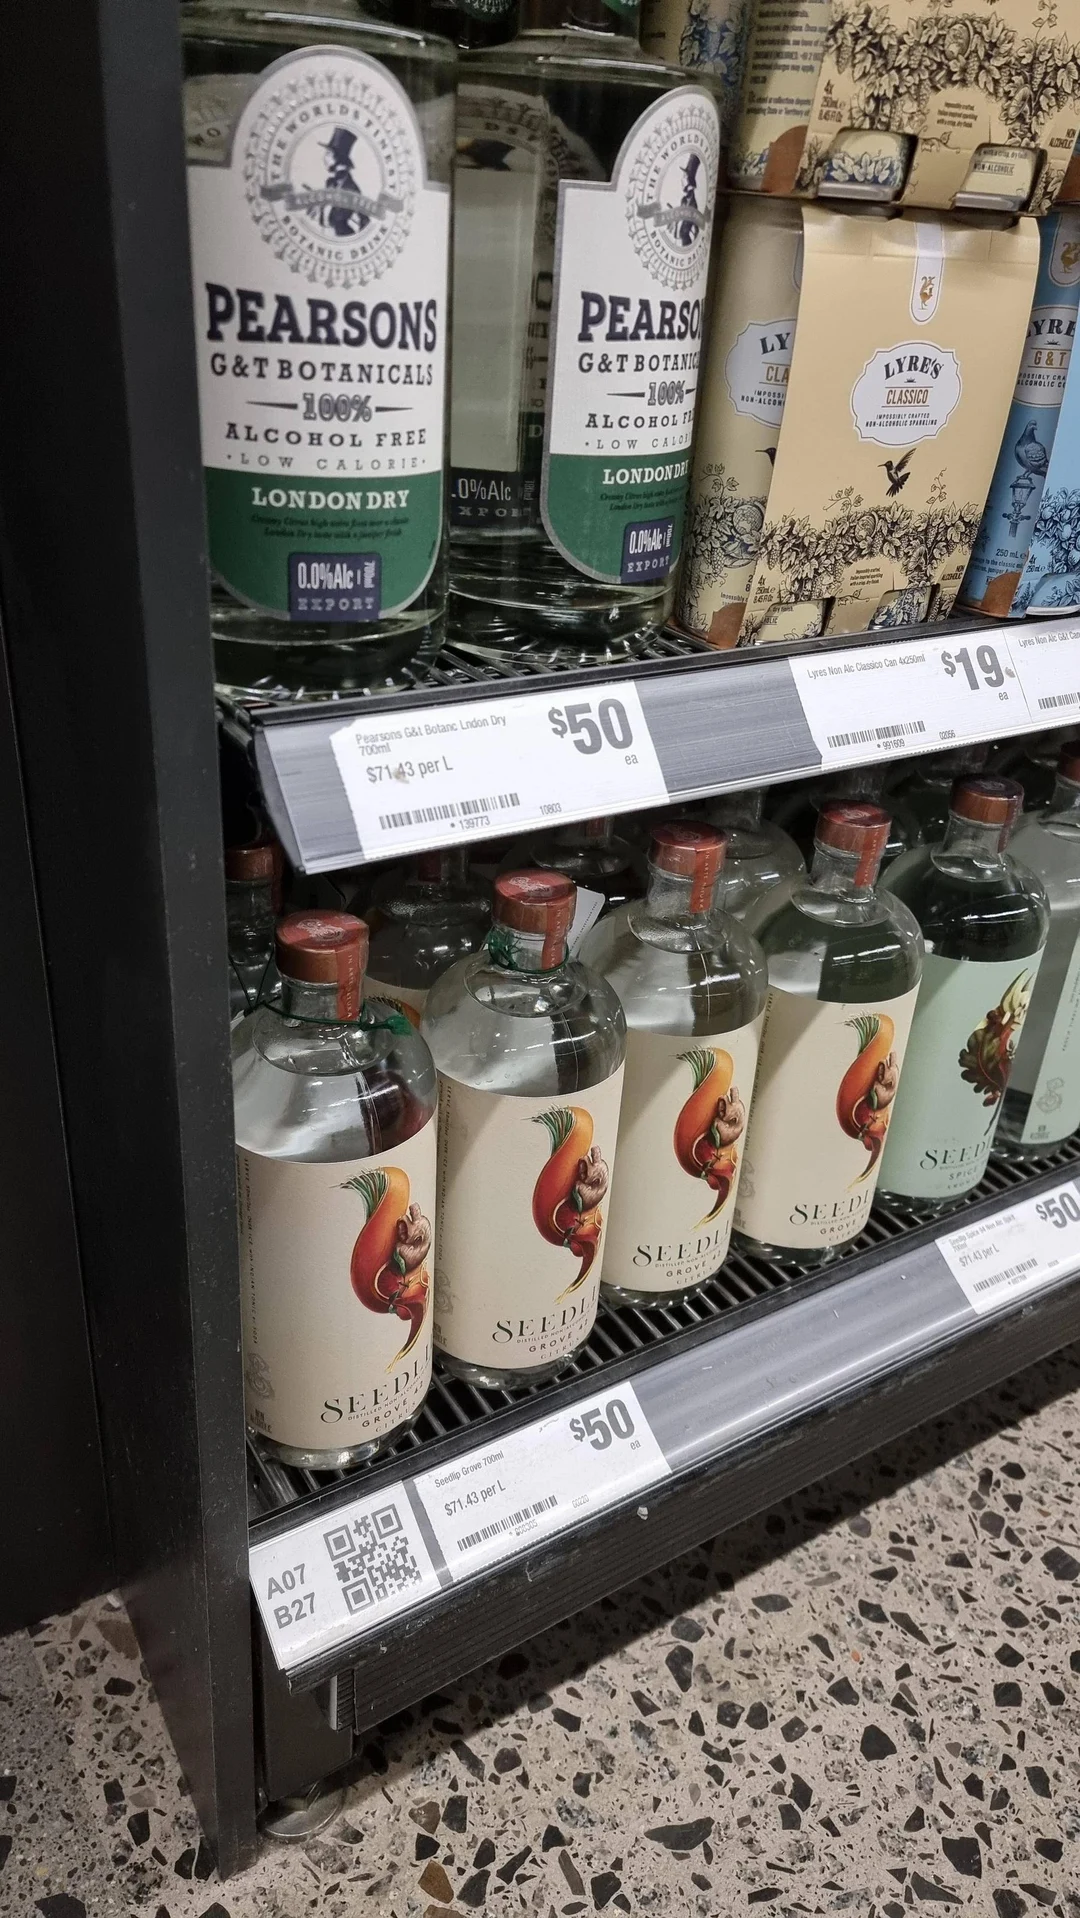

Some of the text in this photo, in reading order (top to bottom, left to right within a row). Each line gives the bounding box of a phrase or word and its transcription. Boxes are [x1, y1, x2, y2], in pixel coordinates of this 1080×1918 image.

[283, 216, 388, 261] BOTANIC DRINK
[205, 282, 436, 352] PEARSONS
[578, 290, 703, 343] PEARSO
[760, 332, 790, 355] LY
[211, 353, 433, 386] G&T BOTANICALS
[578, 352, 628, 373] G&T
[884, 355, 944, 380] LYRE'S
[766, 366, 790, 384] CLA
[1018, 372, 1050, 380] POSSIBLY
[647, 380, 685, 406] 100%
[741, 395, 785, 406] NON-ALCOH
[754, 390, 784, 399] IMPOSSI
[886, 389, 928, 405] CLASSICO
[302, 393, 372, 422] 100%
[585, 412, 678, 429] ALCOHOL
[225, 422, 426, 447] ALCOHOL FREE
[596, 438, 638, 450] LOW
[240, 453, 418, 470] LOW CALORIE
[602, 465, 673, 484] LONDON
[251, 487, 410, 510] LONDON DRY
[450, 478, 511, 501] .0%Alc
[627, 556, 669, 573] EXPORT
[996, 548, 1019, 559] 250 mL
[298, 562, 354, 590] 0.0%Alc
[758, 575, 766, 586] 4x
[298, 597, 375, 611] EXPORT
[1018, 639, 1035, 648] Lyres
[1035, 636, 1047, 644] Non
[1048, 634, 1057, 643] Alc
[807, 654, 926, 680] Lyres Non Alc Classico Can 4x250ml
[941, 645, 1005, 691] $19
[998, 691, 1009, 701] ea
[355, 714, 507, 745] Pearsons G&t Botanc Lndon Dry
[548, 698, 633, 755] $50
[359, 742, 391, 756] 700ml
[624, 754, 639, 765] ea
[366, 756, 454, 784] $7143 per L
[459, 816, 491, 830] 139773
[790, 1189, 869, 1225] SEEDL
[1036, 1193, 1080, 1228] $50
[820, 1220, 856, 1235] GROVE
[632, 1220, 729, 1267] SEEDLI
[959, 1243, 1000, 1268] $71.43 per L
[666, 1261, 706, 1277] GROVE
[492, 1285, 596, 1344] SEEDLI
[517, 1334, 548, 1344] DISTILLED
[529, 1318, 588, 1353] GROVE 42
[320, 1344, 430, 1424] SEEDLI
[348, 1406, 382, 1421] DISTILLED
[362, 1381, 423, 1428] GROVE 42
[569, 1400, 636, 1451] $50
[630, 1440, 641, 1451] ea
[434, 1450, 504, 1488] Seedlip Grove 700ml
[444, 1479, 506, 1516] $71.43 per L
[266, 1563, 306, 1601] A07
[273, 1593, 317, 1630] B27
